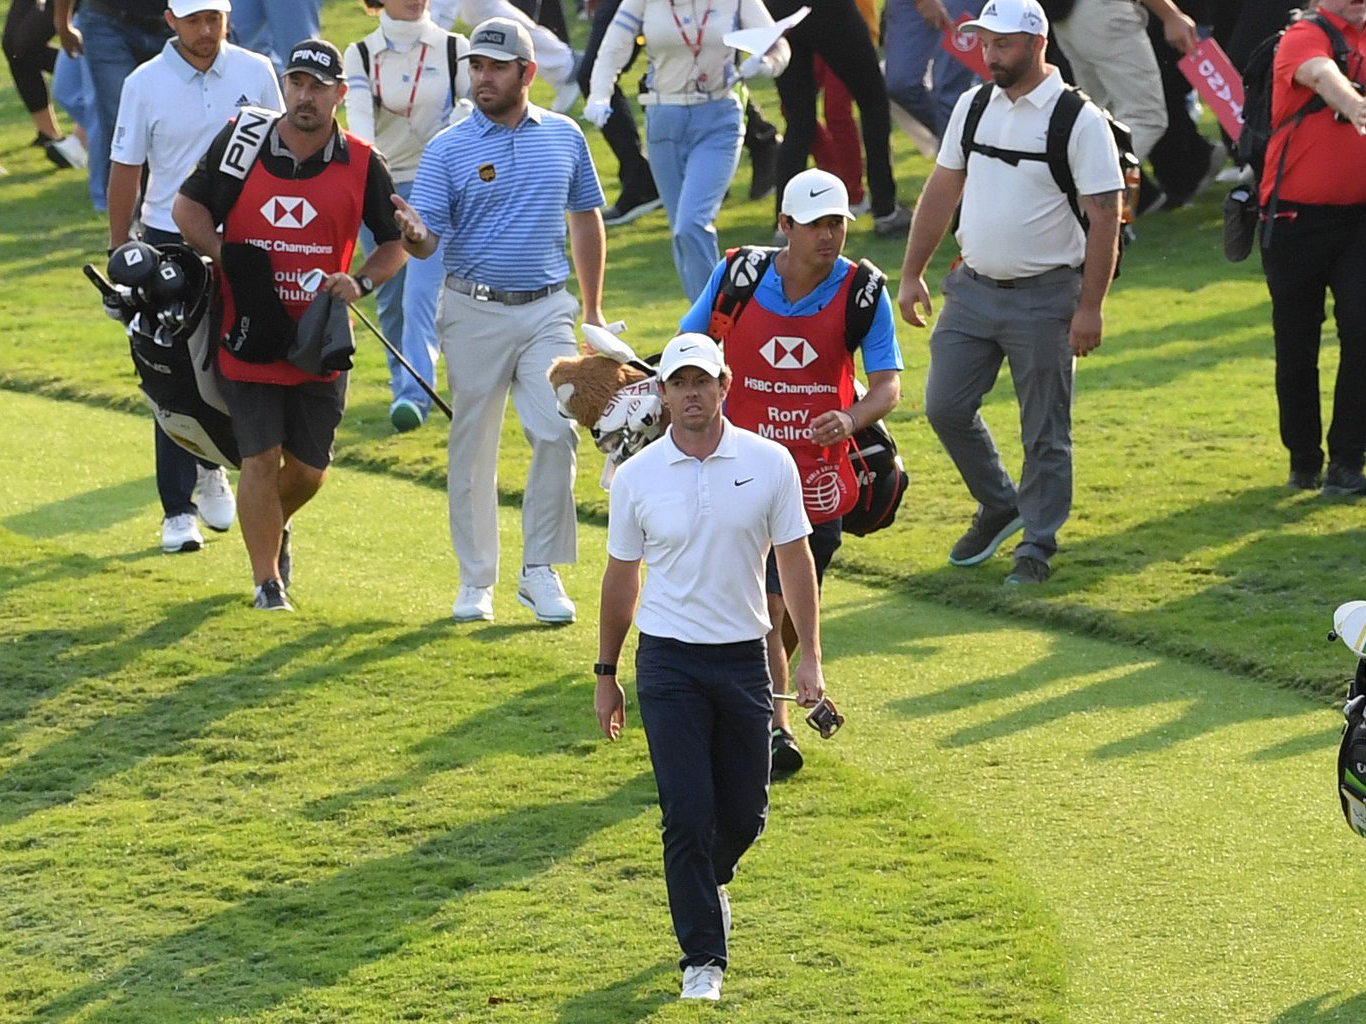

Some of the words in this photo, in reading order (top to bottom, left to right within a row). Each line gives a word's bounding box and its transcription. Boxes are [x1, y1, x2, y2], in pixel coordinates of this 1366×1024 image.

[291, 49, 332, 68] PING
[273, 240, 333, 256] Champions
[744, 376, 773, 393] HSBC
[774, 381, 838, 396] Champions
[767, 406, 810, 425] Rory
[758, 423, 815, 441] McIlro
